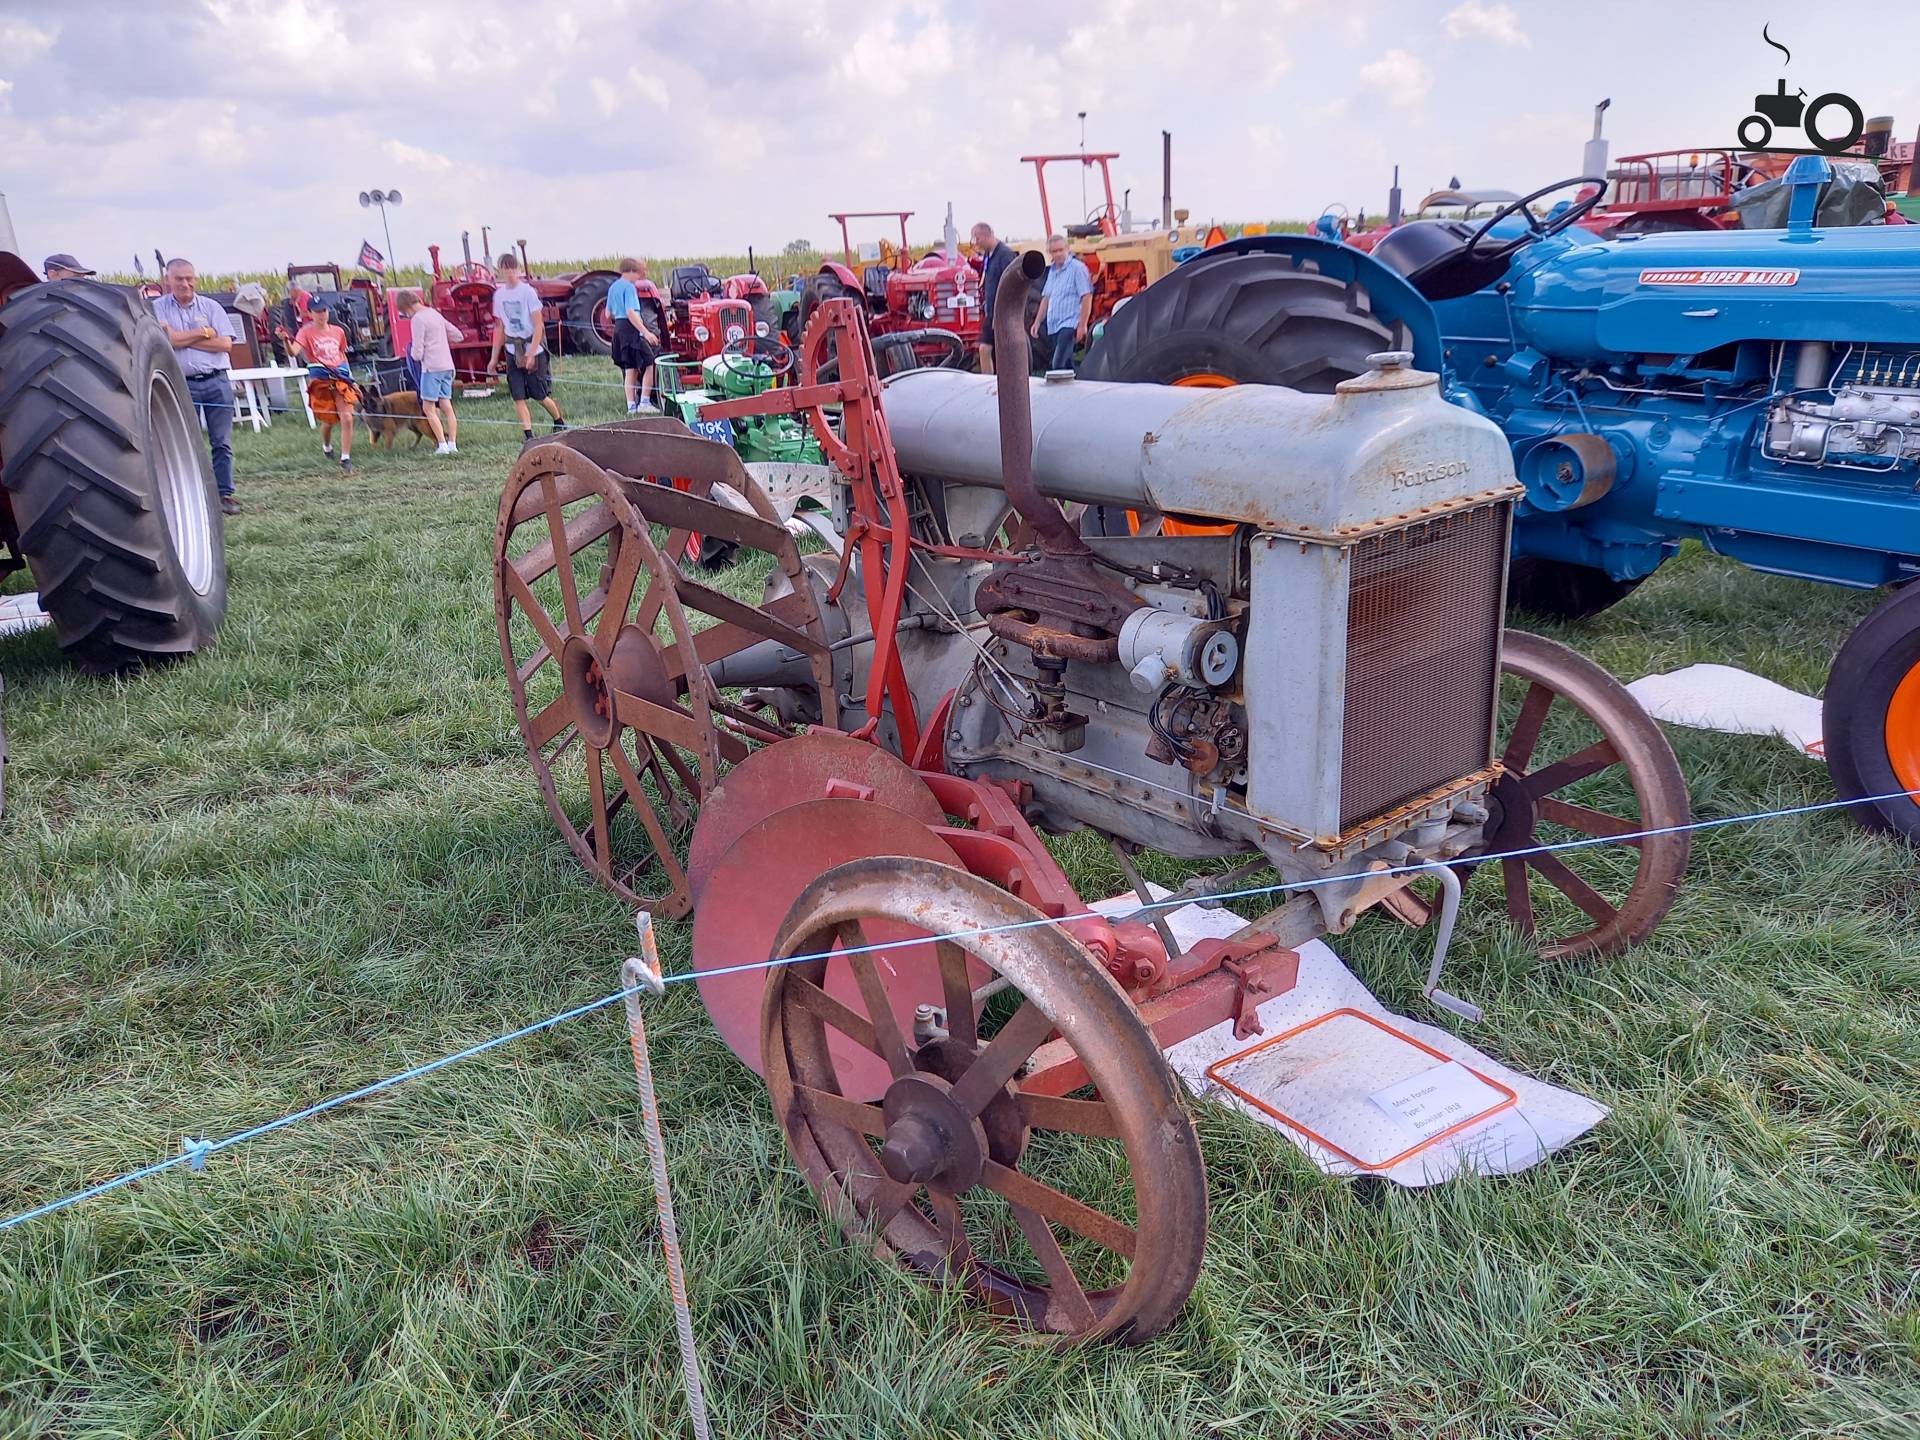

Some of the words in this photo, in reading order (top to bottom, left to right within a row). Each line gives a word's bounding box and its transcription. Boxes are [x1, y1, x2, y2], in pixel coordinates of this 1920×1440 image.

[1699, 271, 1743, 284] SUPER
[1743, 271, 1794, 284] MAJOR
[697, 421, 725, 435] TGK
[1391, 461, 1471, 492] Fordson
[1410, 1086, 1437, 1099] Fordson
